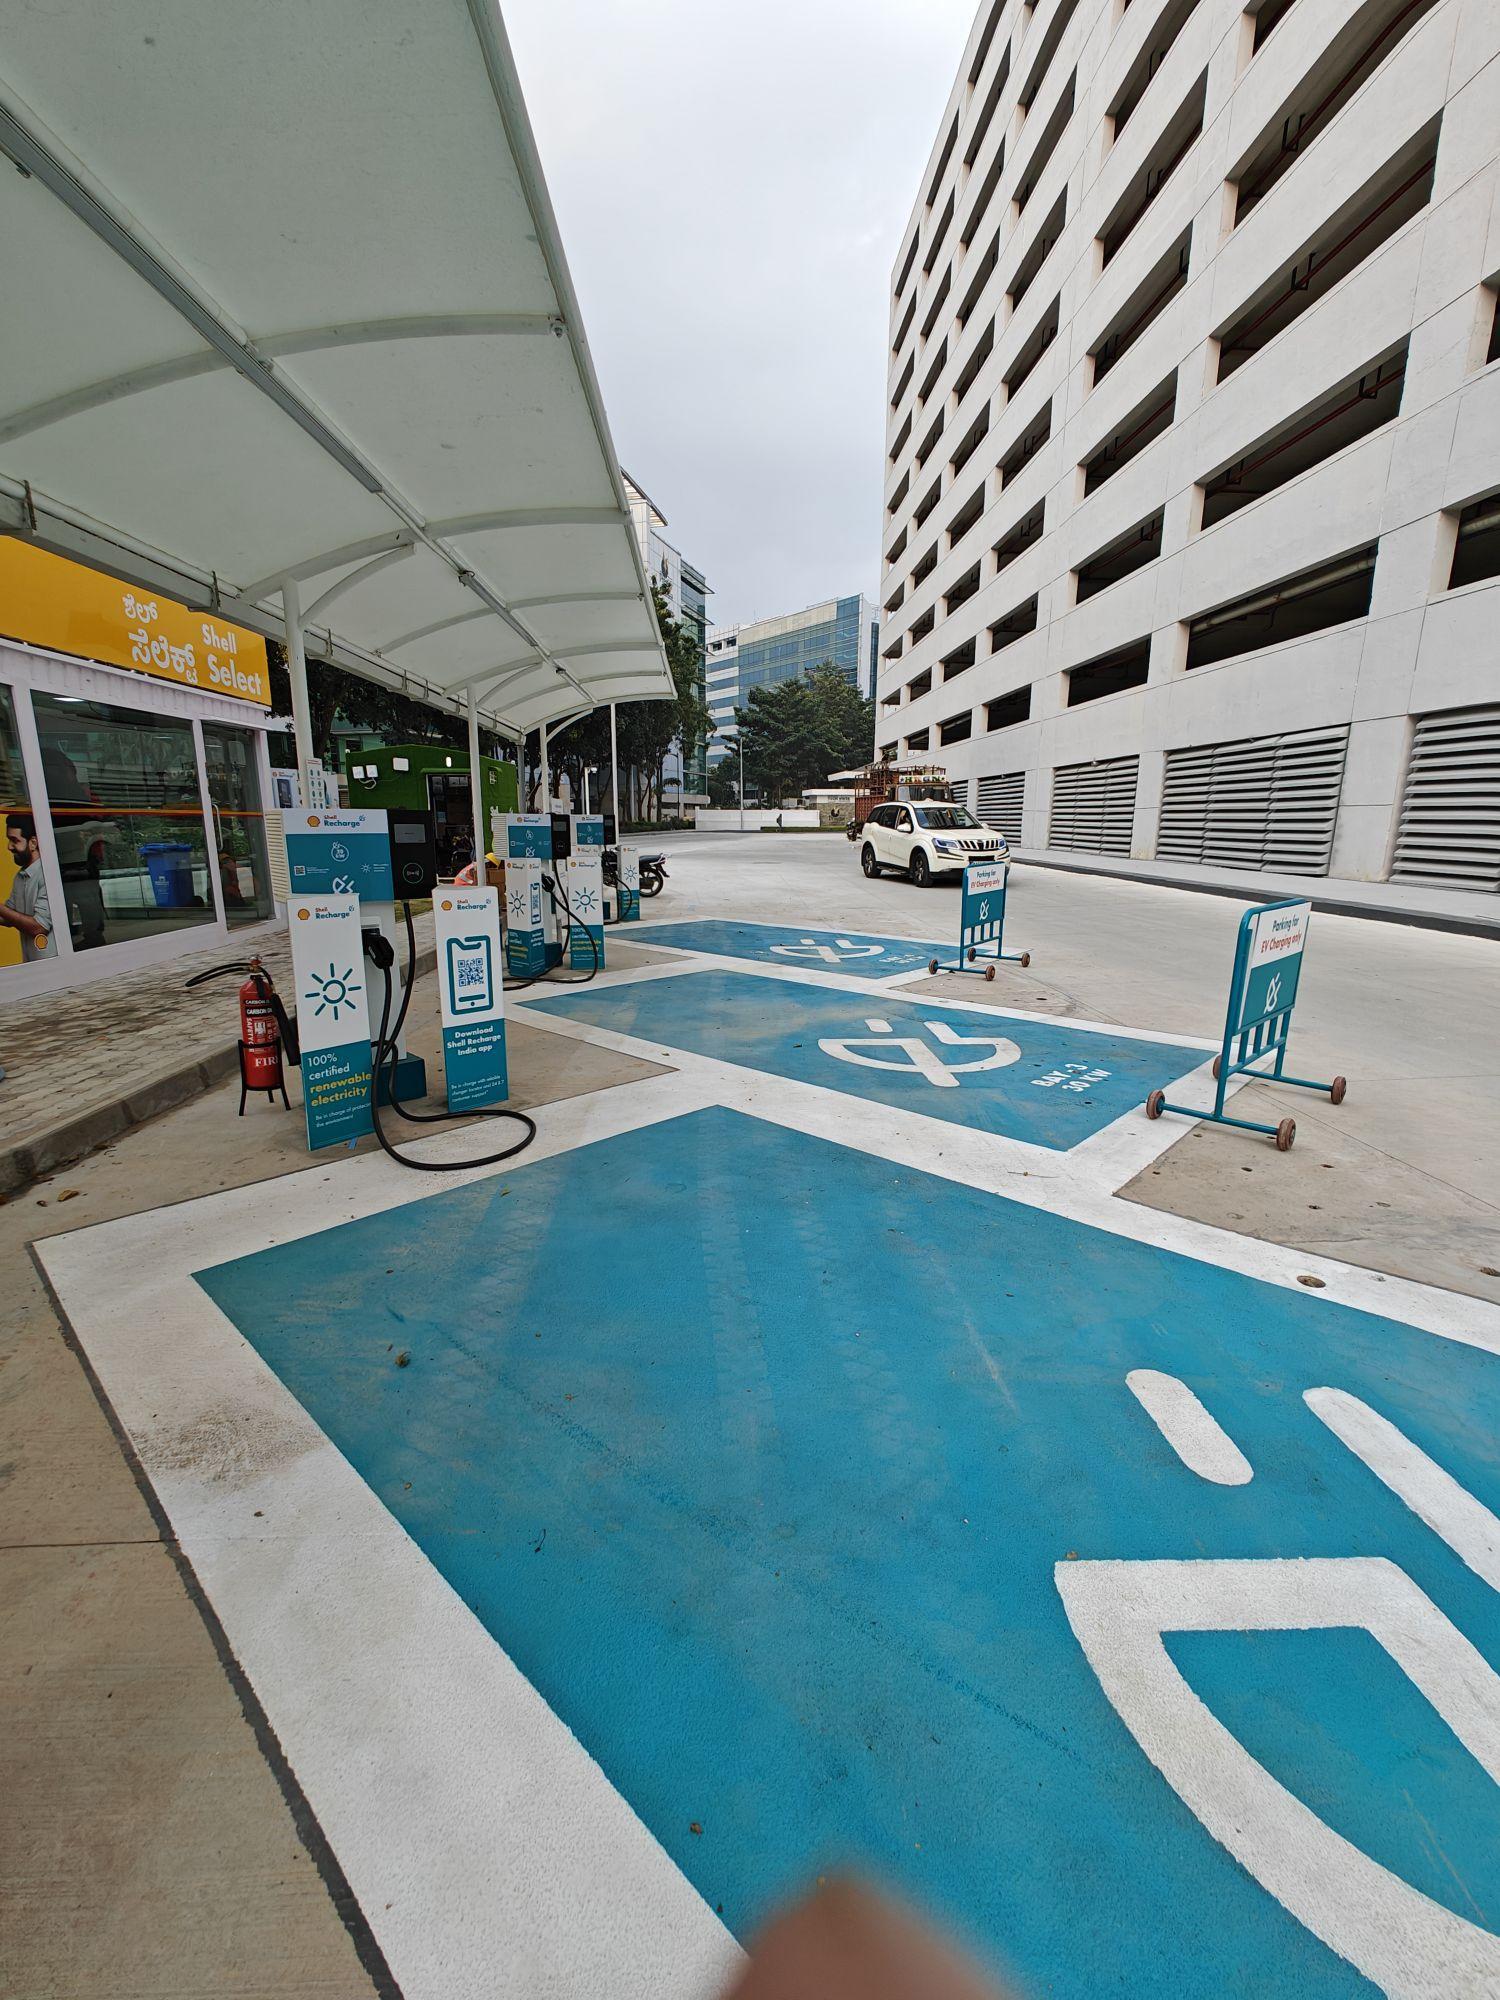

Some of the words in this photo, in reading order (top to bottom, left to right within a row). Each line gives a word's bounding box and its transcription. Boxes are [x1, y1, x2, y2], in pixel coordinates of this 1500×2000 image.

[122, 593, 158, 624] ಶೆಲ್
[201, 623, 237, 655] Shell
[207, 653, 262, 696] Select
[324, 820, 361, 828] Recharge
[976, 869, 991, 878] Parking
[976, 880, 992, 888] Charging
[456, 903, 487, 911] Recharge
[315, 911, 350, 920] Recharge
[1272, 916, 1292, 932] Parking
[1291, 913, 1300, 927] for
[1261, 938, 1270, 953] EV
[1269, 935, 1292, 950] Charging
[1291, 931, 1303, 945] only
[454, 1025, 494, 1038] Download
[447, 1038, 466, 1049] Shell
[467, 1033, 502, 1045] Recharge
[457, 1047, 477, 1056] India
[478, 1044, 493, 1053] app
[308, 1053, 338, 1067] 100%
[309, 1062, 350, 1081] certified
[1029, 1070, 1071, 1087] BAY
[1079, 1068, 1112, 1082] KW
[310, 1072, 373, 1094] renewable
[311, 1086, 368, 1107] electricity
